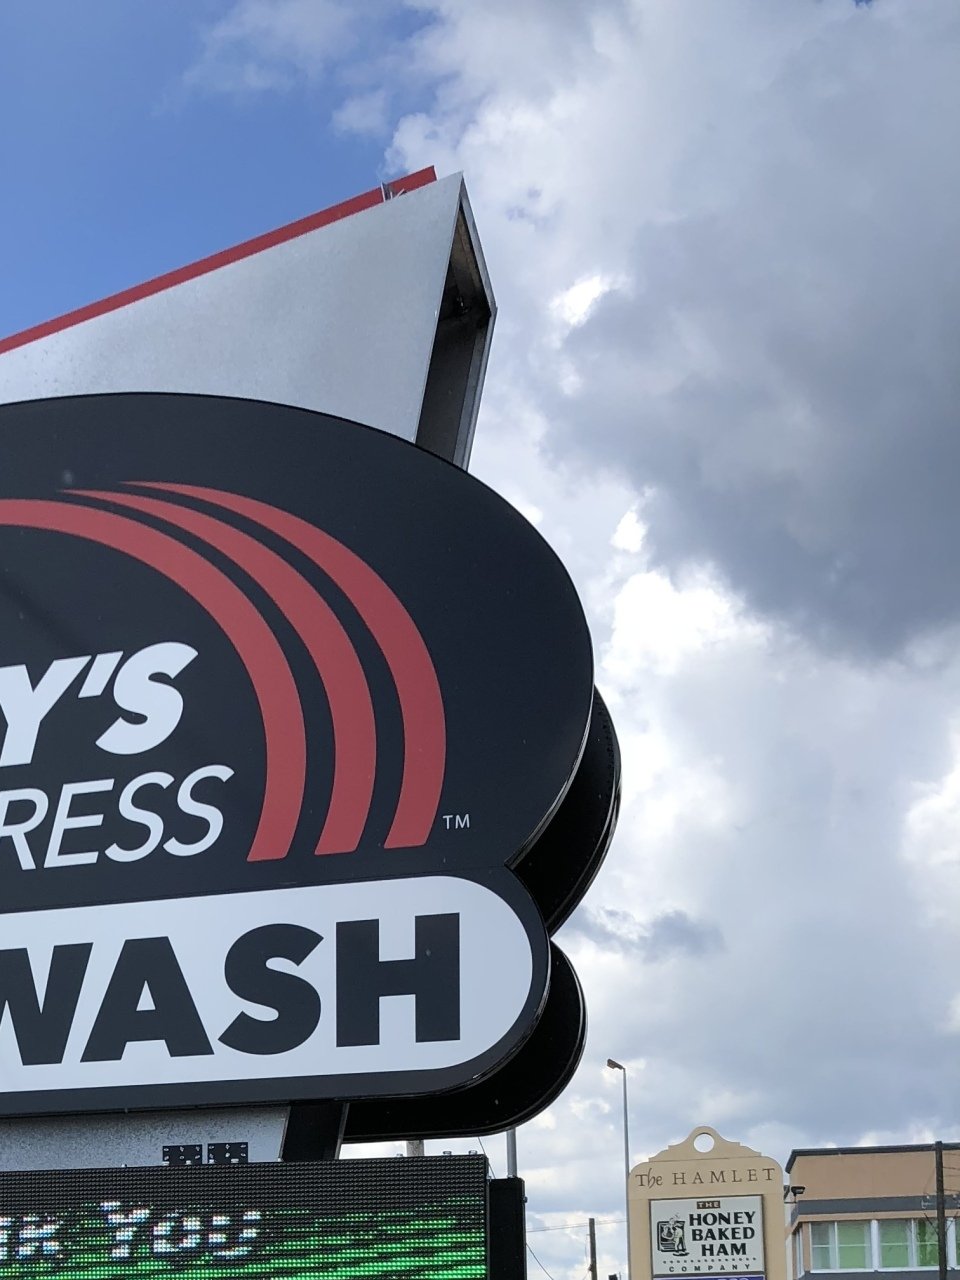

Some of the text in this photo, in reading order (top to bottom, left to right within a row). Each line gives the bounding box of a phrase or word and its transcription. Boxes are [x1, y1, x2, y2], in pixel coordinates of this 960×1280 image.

[442, 813, 470, 830] TM
[635, 1168, 775, 1189] The HAMLET
[689, 1211, 756, 1227] HONEY
[691, 1226, 755, 1242] BAKED
[701, 1243, 747, 1257] HAM
[669, 1263, 750, 1273] COMPANY
